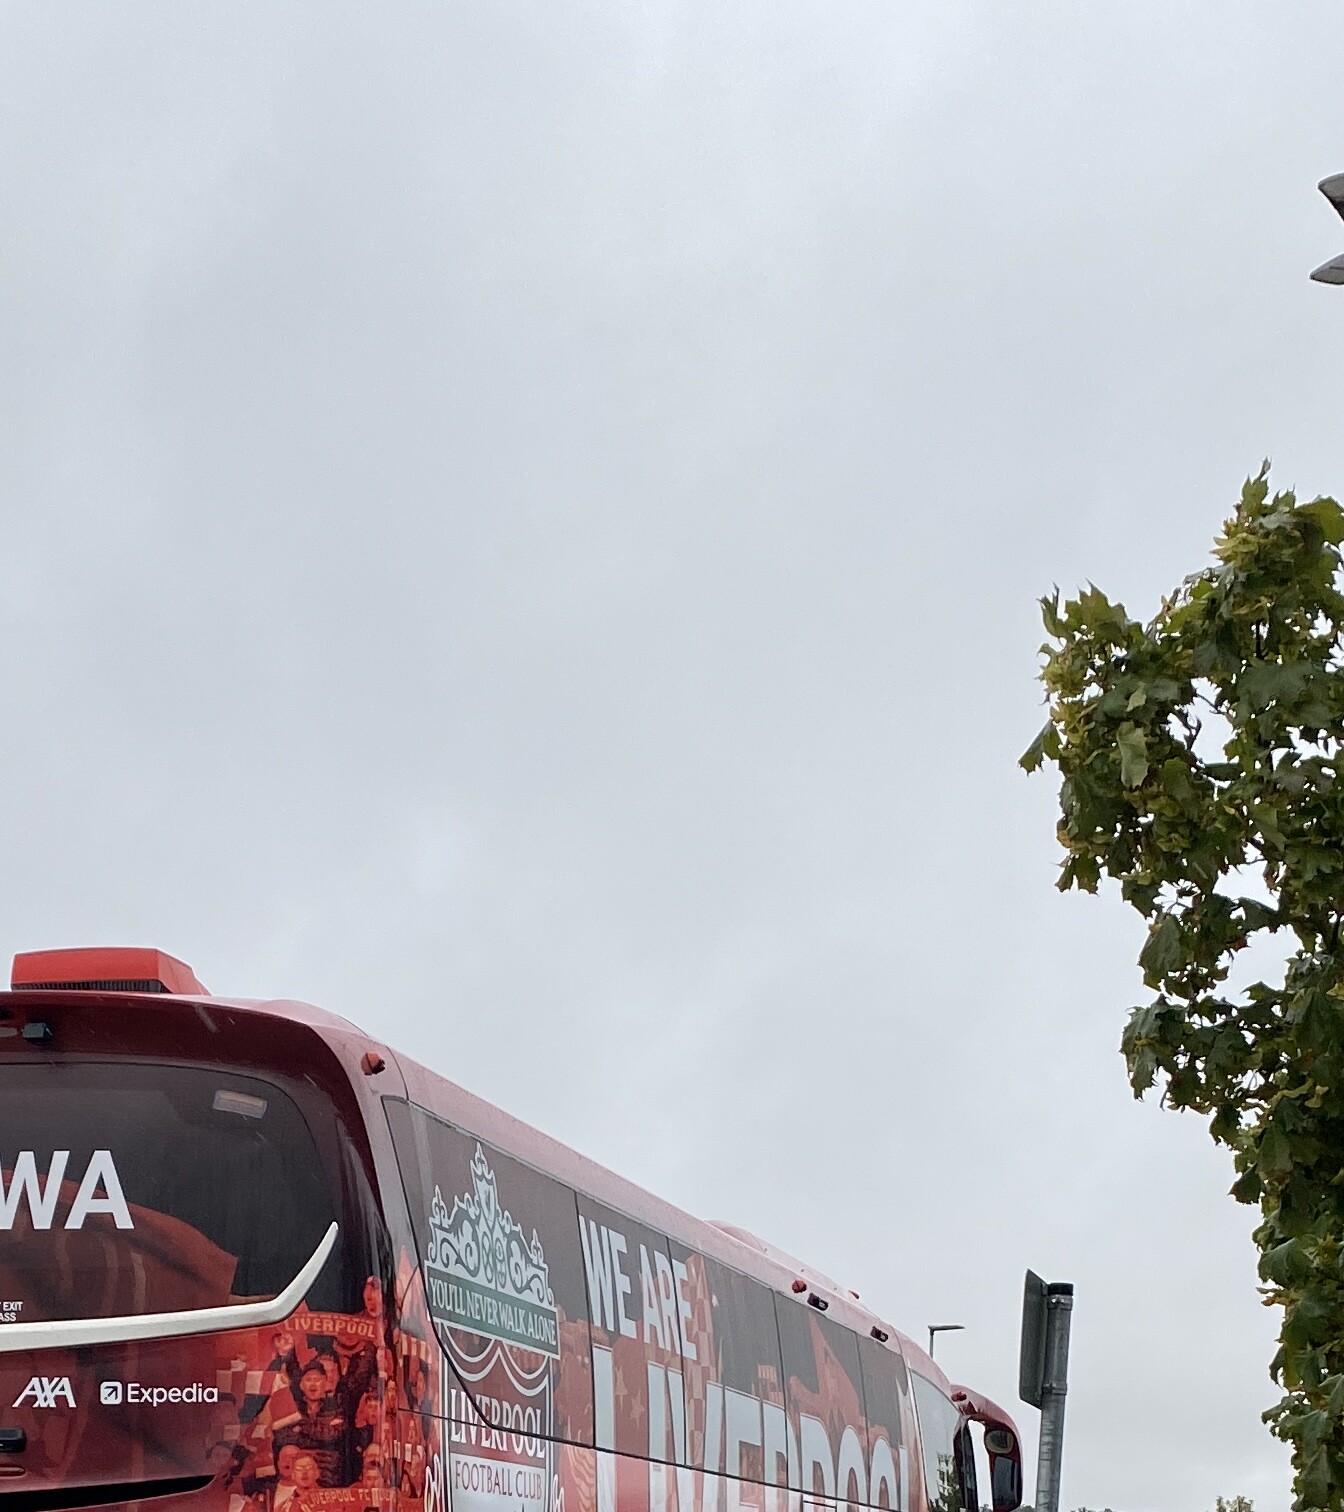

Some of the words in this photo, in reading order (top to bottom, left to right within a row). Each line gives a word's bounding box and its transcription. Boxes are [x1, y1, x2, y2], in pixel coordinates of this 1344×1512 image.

[579, 1215, 637, 1339] WE
[639, 1244, 697, 1361] ARE
[2, 1301, 23, 1311] EXIT
[429, 1277, 466, 1315] YOU'LL
[465, 1289, 500, 1327] NEVER
[498, 1301, 528, 1336] WALK
[527, 1312, 557, 1346] ALONE
[284, 1318, 375, 1338] LIVERPOOL
[12, 1377, 77, 1408] AXA
[127, 1383, 219, 1407] Expedia
[451, 1389, 545, 1459] LIVERPOOL
[455, 1460, 513, 1497] FOOTBALL
[516, 1470, 543, 1500] CLUB
